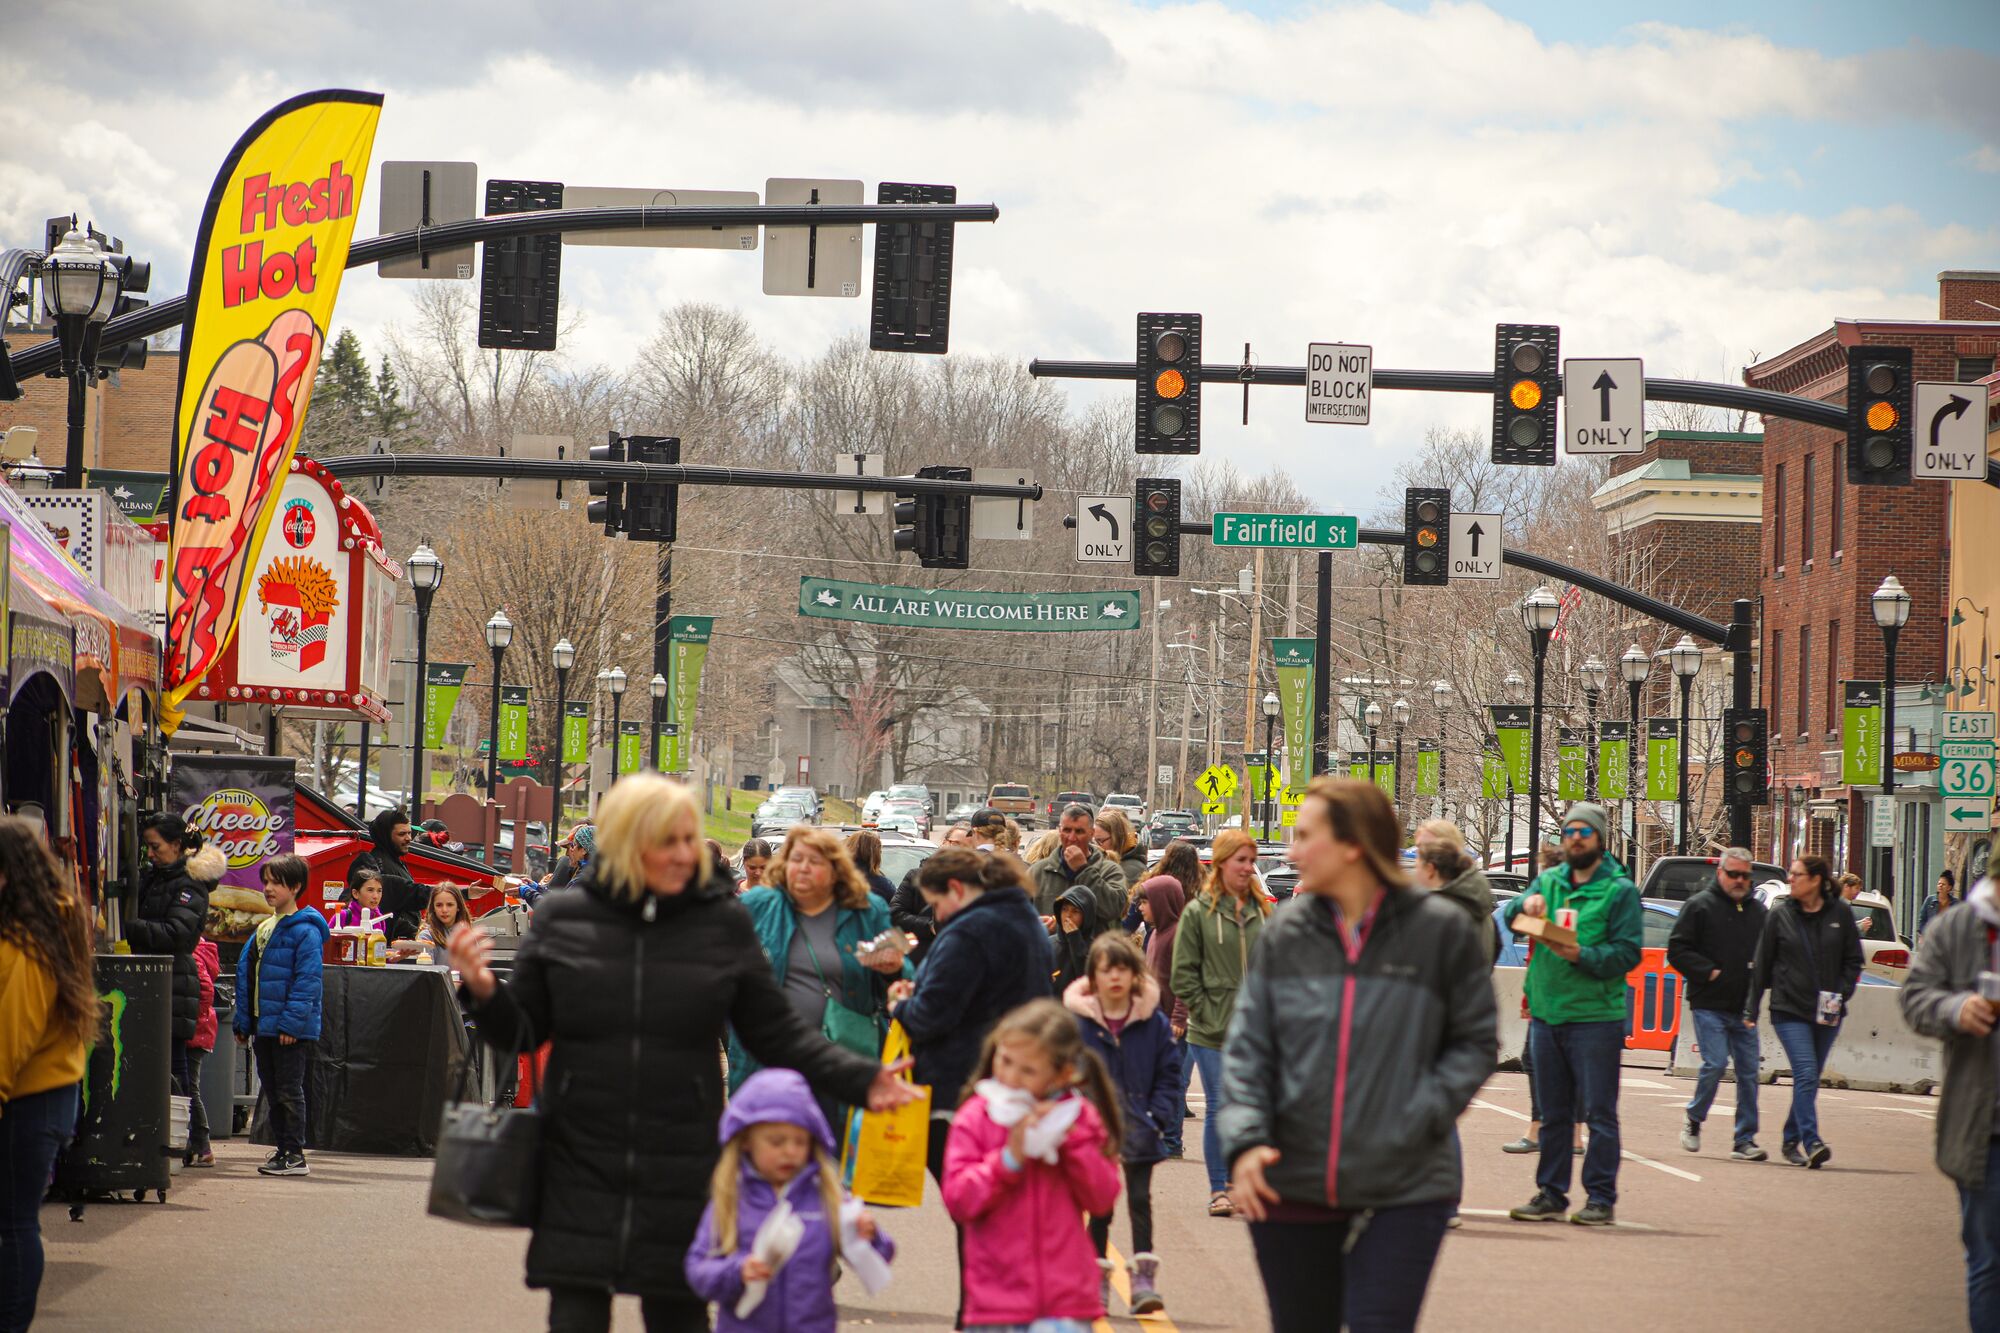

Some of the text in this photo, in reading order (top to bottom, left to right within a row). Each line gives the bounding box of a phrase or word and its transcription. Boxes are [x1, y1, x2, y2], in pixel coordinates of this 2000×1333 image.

[240, 160, 353, 235] Fresh
[222, 235, 317, 308] Hot
[1312, 354, 1367, 373] DO NOT
[1311, 380, 1366, 399] BLOCK
[1309, 402, 1367, 417] INTERSECTION
[1577, 427, 1632, 445] ONLY
[1925, 452, 1976, 471] ONLY
[119, 502, 154, 510] ALBANS
[1223, 517, 1347, 544] Fairfield St
[1085, 544, 1123, 557] ONLY
[1455, 561, 1493, 574] ONLY
[851, 594, 1089, 620] ALL ARE WELCOME HERE
[427, 687, 437, 740] DOWNTOWN
[677, 646, 687, 759] BIENVENUE
[508, 710, 519, 751] DINE
[571, 720, 580, 756] SHOP
[1293, 678, 1305, 771] WELCOME
[1949, 716, 1988, 733] EAST
[1856, 714, 1867, 772] STAY
[1945, 746, 1990, 757] VERMONT
[1519, 731, 1529, 785] DOWNTOWN
[1567, 752, 1577, 792] DINE
[1607, 747, 1618, 789] SHOP
[1658, 744, 1667, 791] PLAY
[1950, 762, 1985, 791] 36
[214, 793, 255, 806] Philly
[182, 804, 286, 832] Cheese
